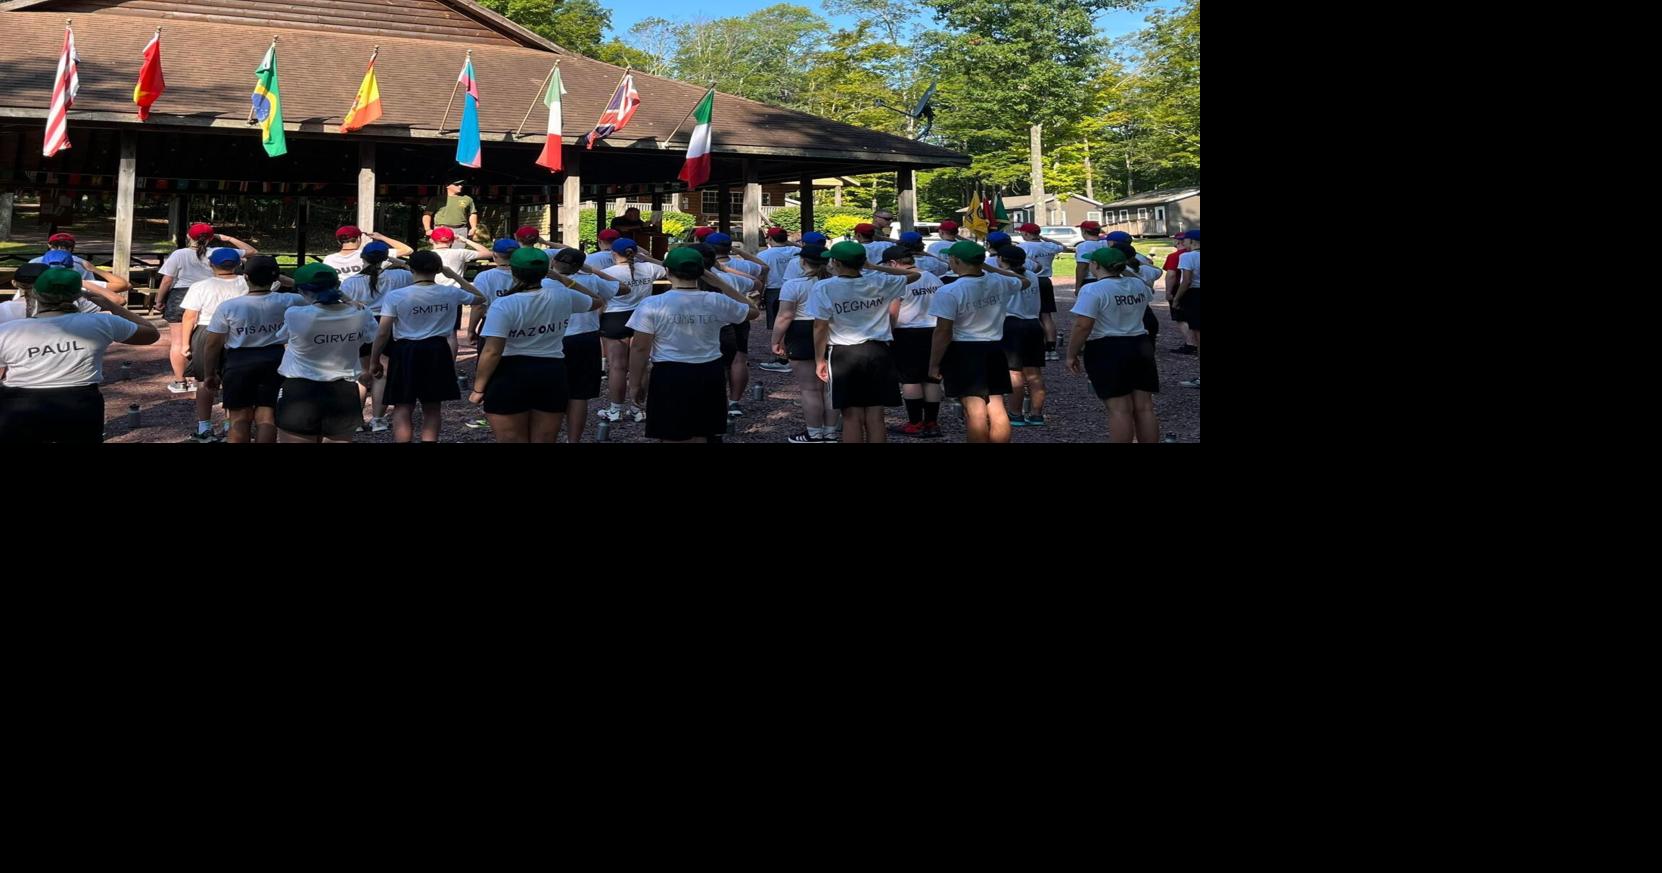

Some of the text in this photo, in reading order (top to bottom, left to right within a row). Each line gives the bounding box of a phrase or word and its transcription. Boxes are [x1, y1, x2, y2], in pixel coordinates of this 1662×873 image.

[834, 296, 885, 315] DEGNAN
[1114, 293, 1146, 306] BROWN
[412, 303, 449, 315] SMITH
[313, 329, 365, 345] GIRVEN
[508, 319, 569, 338] MAZONIS
[27, 340, 85, 358] PAUL
